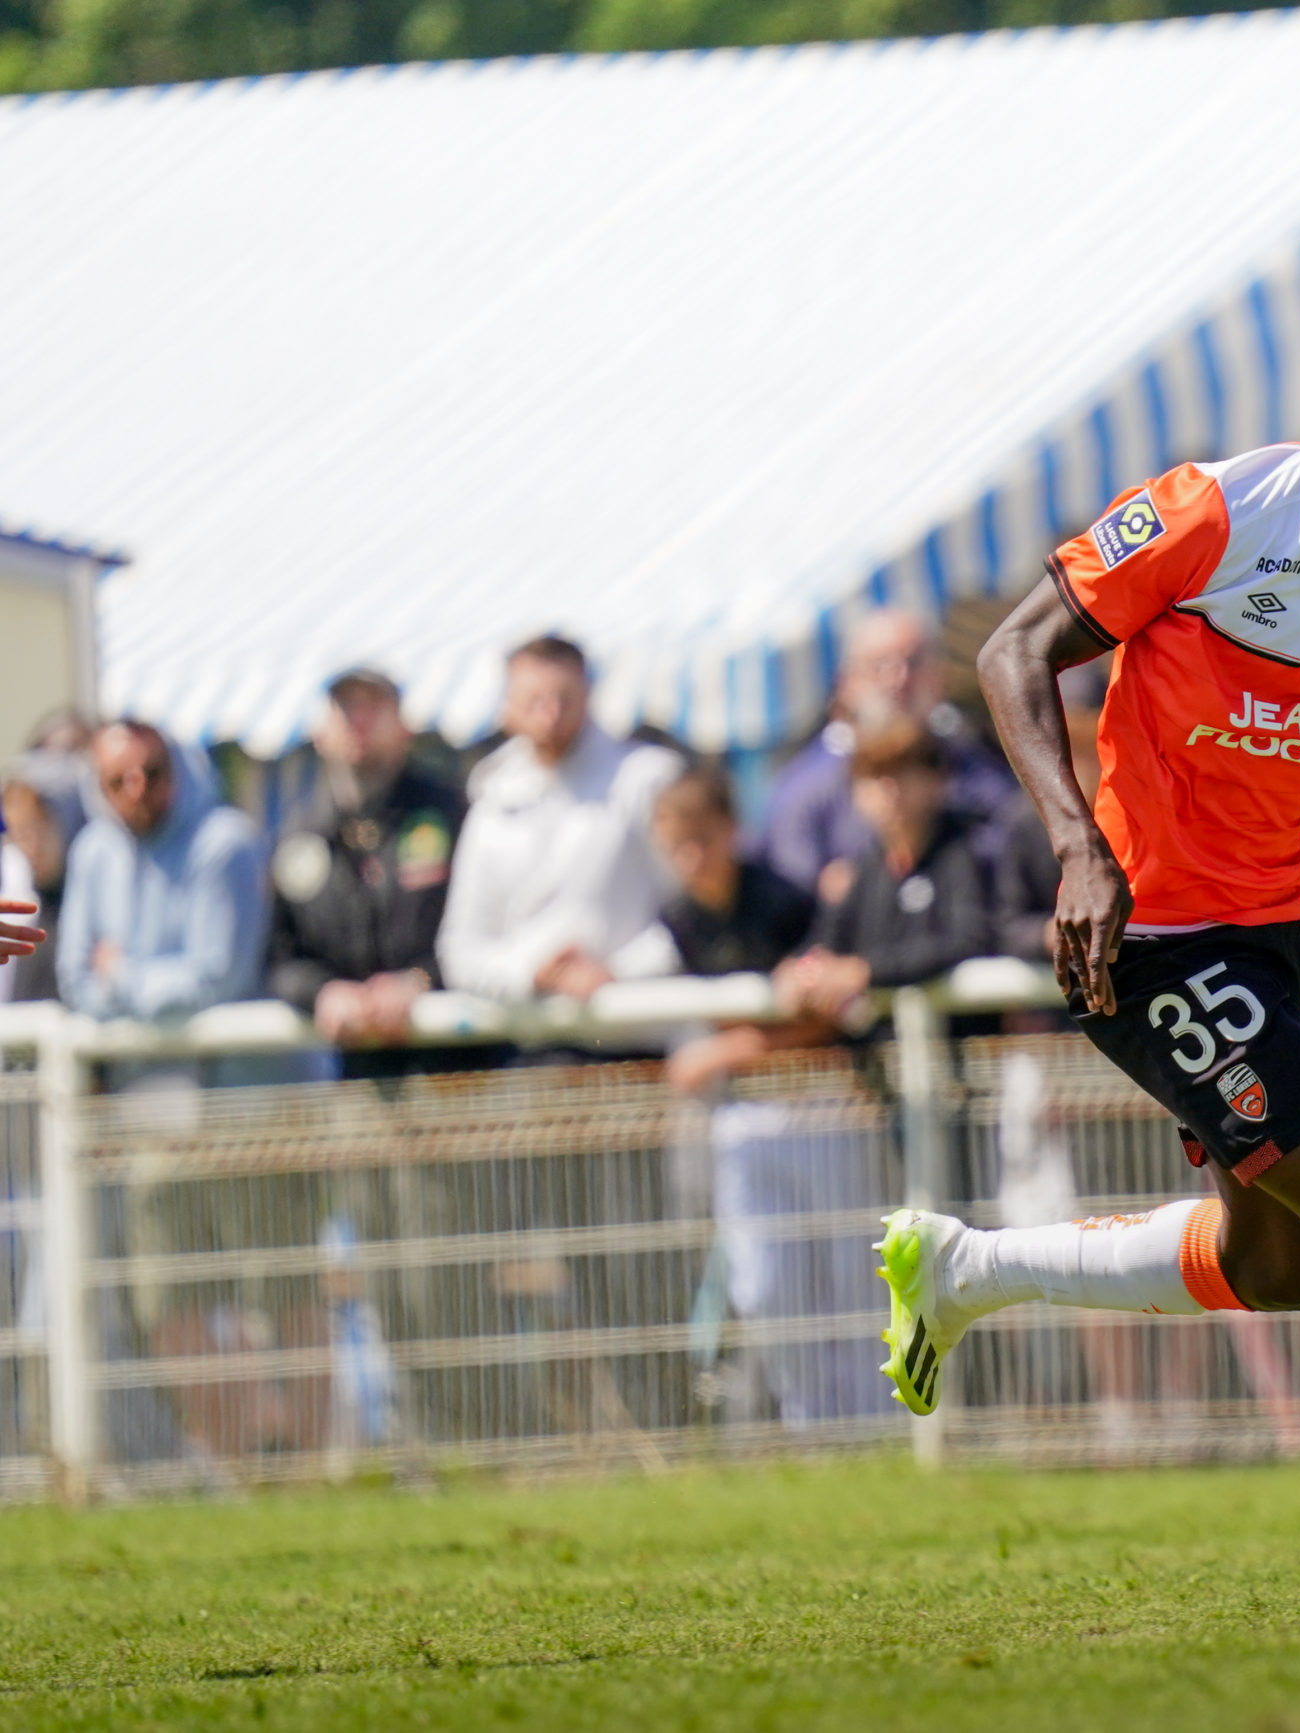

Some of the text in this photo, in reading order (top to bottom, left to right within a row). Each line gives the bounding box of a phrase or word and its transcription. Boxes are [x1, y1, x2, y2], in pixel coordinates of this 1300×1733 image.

[1105, 522, 1121, 551] LIGUE
[1241, 610, 1278, 629] umbro
[1148, 960, 1266, 1074] 35
